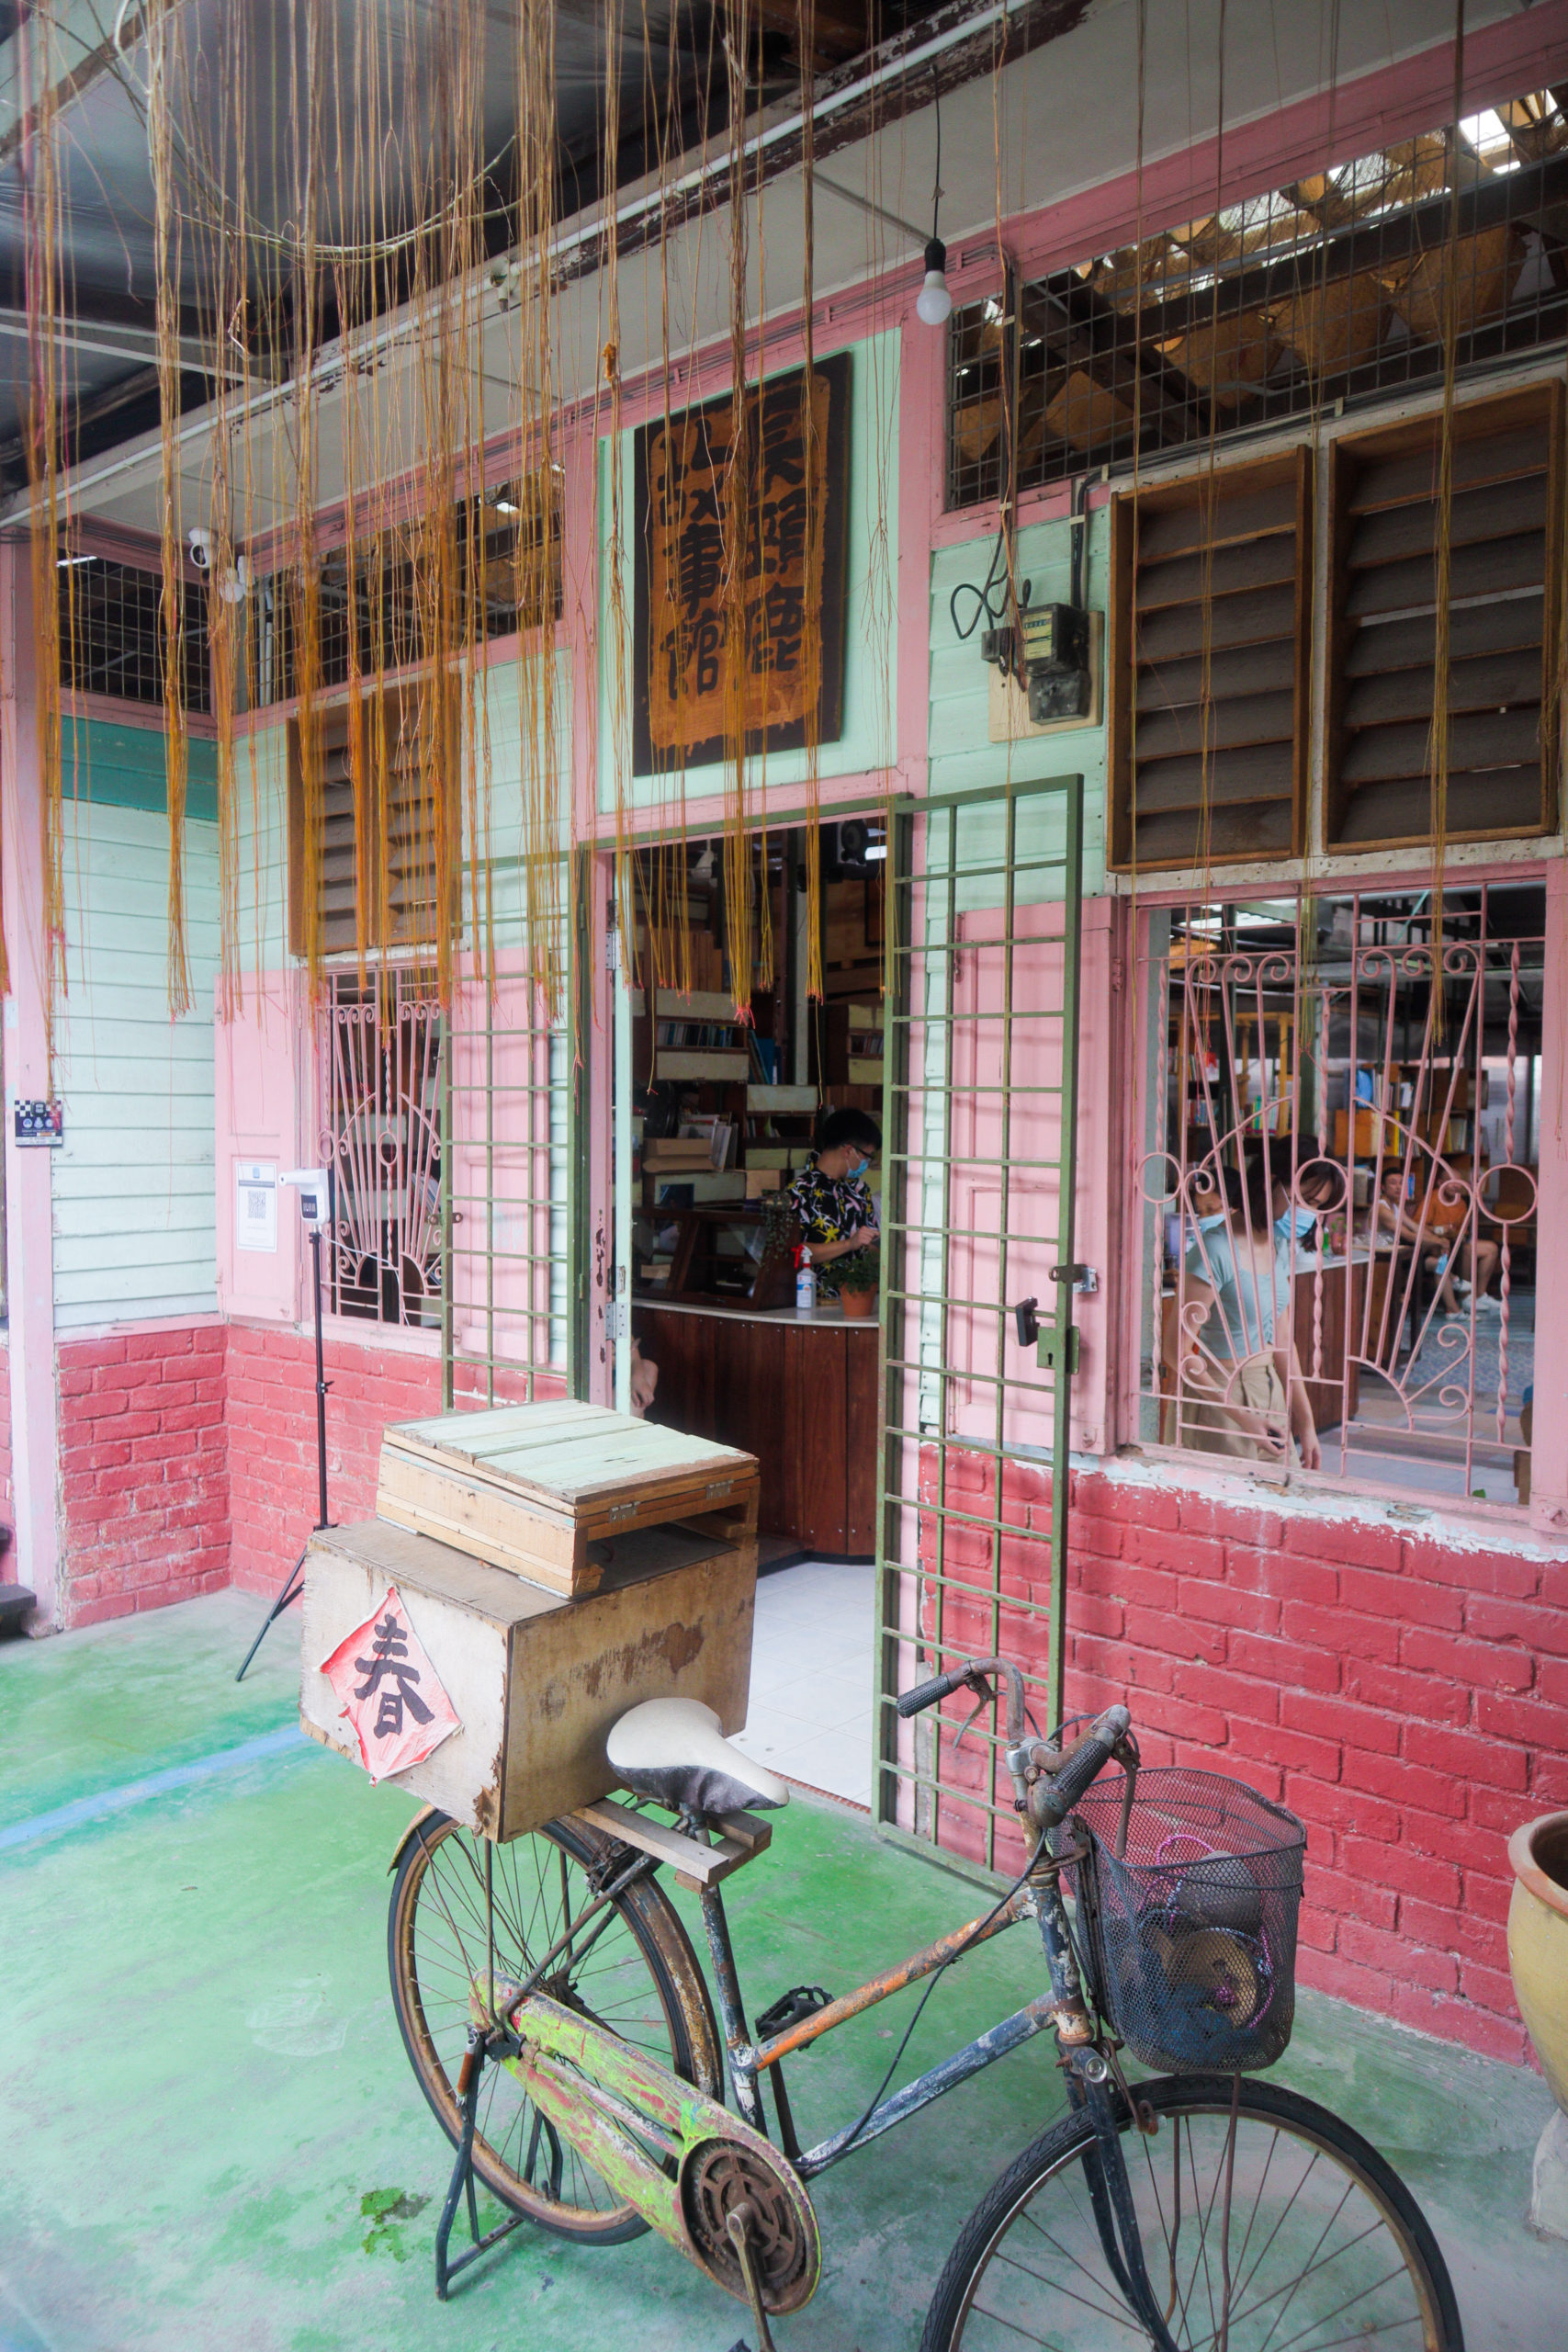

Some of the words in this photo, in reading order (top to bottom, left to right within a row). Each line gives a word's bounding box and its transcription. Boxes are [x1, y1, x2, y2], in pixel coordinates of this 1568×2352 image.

[659, 419, 733, 699] 故事館
[355, 1614, 434, 1738] 春
